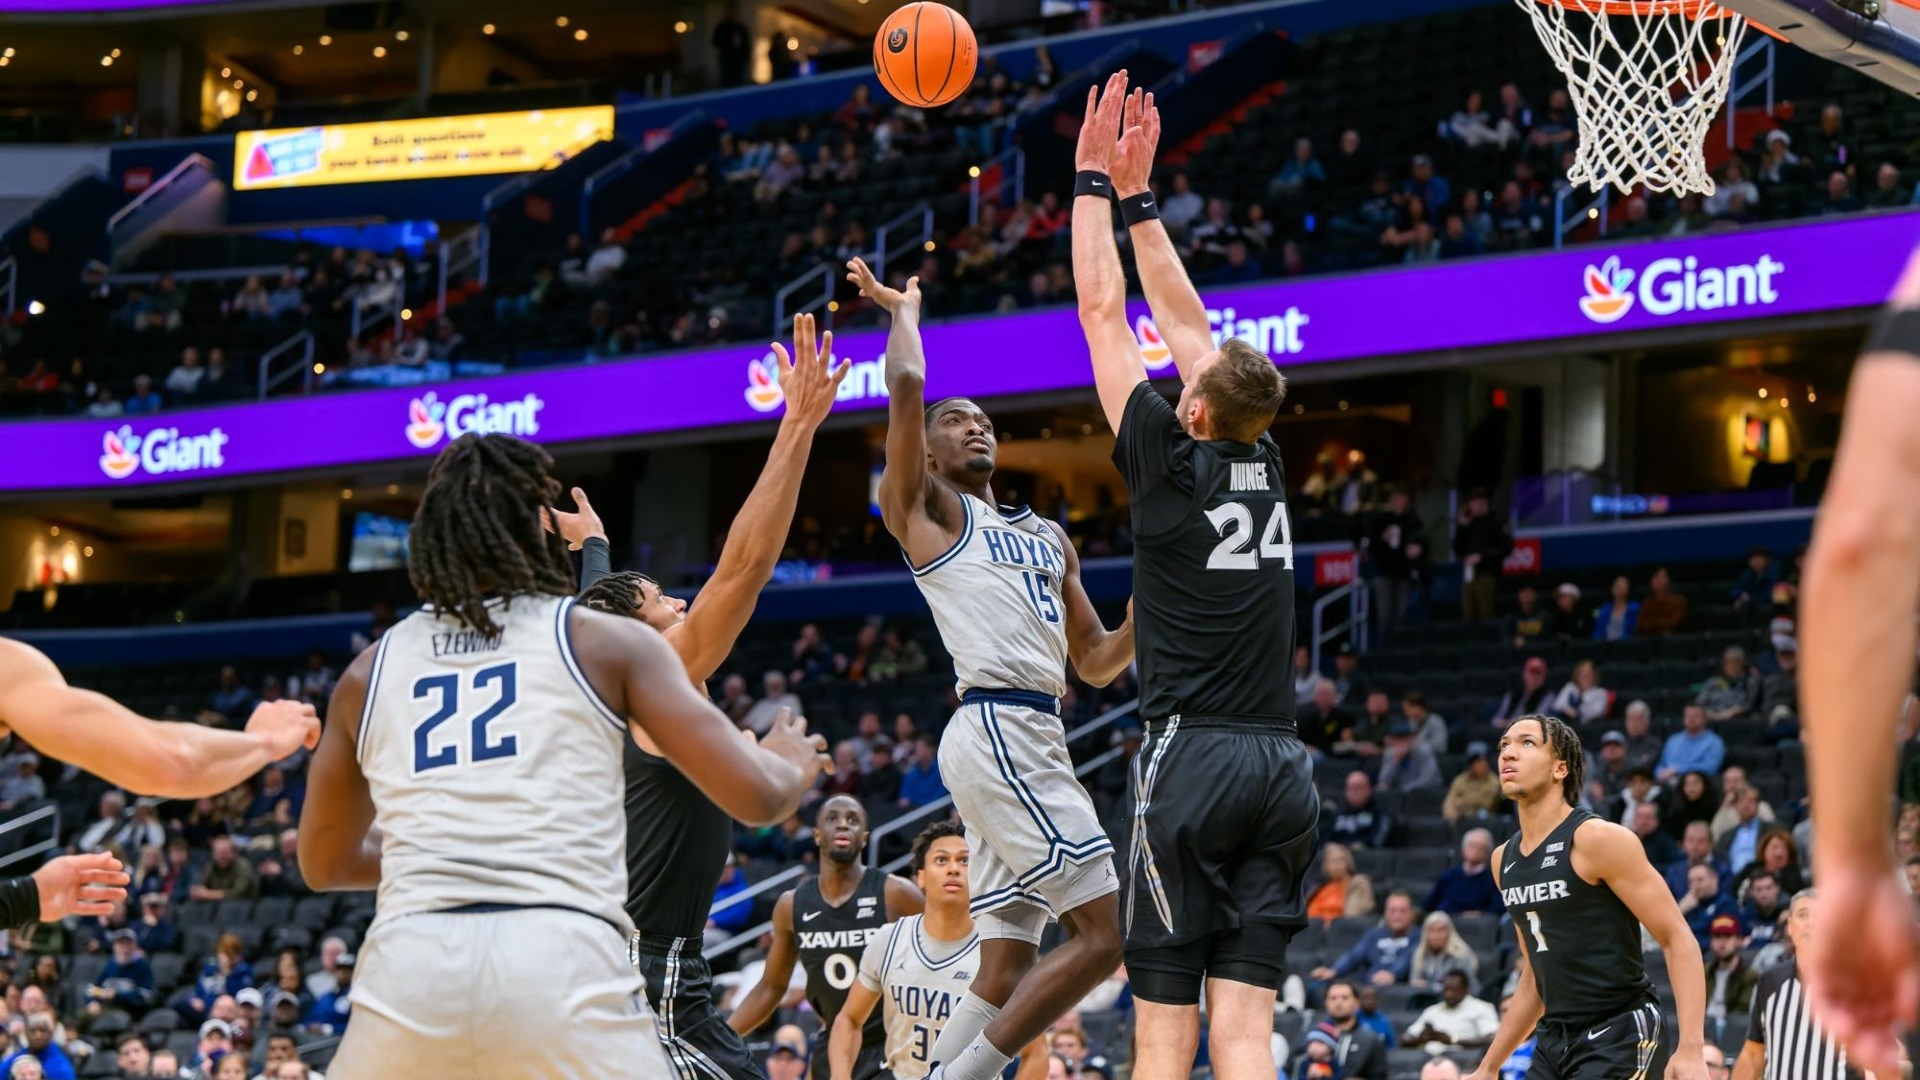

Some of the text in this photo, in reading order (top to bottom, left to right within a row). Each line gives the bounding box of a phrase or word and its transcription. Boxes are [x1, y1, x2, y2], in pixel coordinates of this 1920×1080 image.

[1638, 254, 1785, 316] Giant
[1206, 306, 1310, 355] iant
[445, 392, 544, 440] Giant
[141, 427, 229, 474] Giant
[1229, 462, 1270, 491] NUNGE
[1203, 501, 1294, 570] 24
[1021, 570, 1059, 623] 15
[412, 659, 518, 775] 22
[1525, 910, 1549, 952] 1
[824, 953, 857, 990] 0
[890, 984, 962, 1021] HOYA
